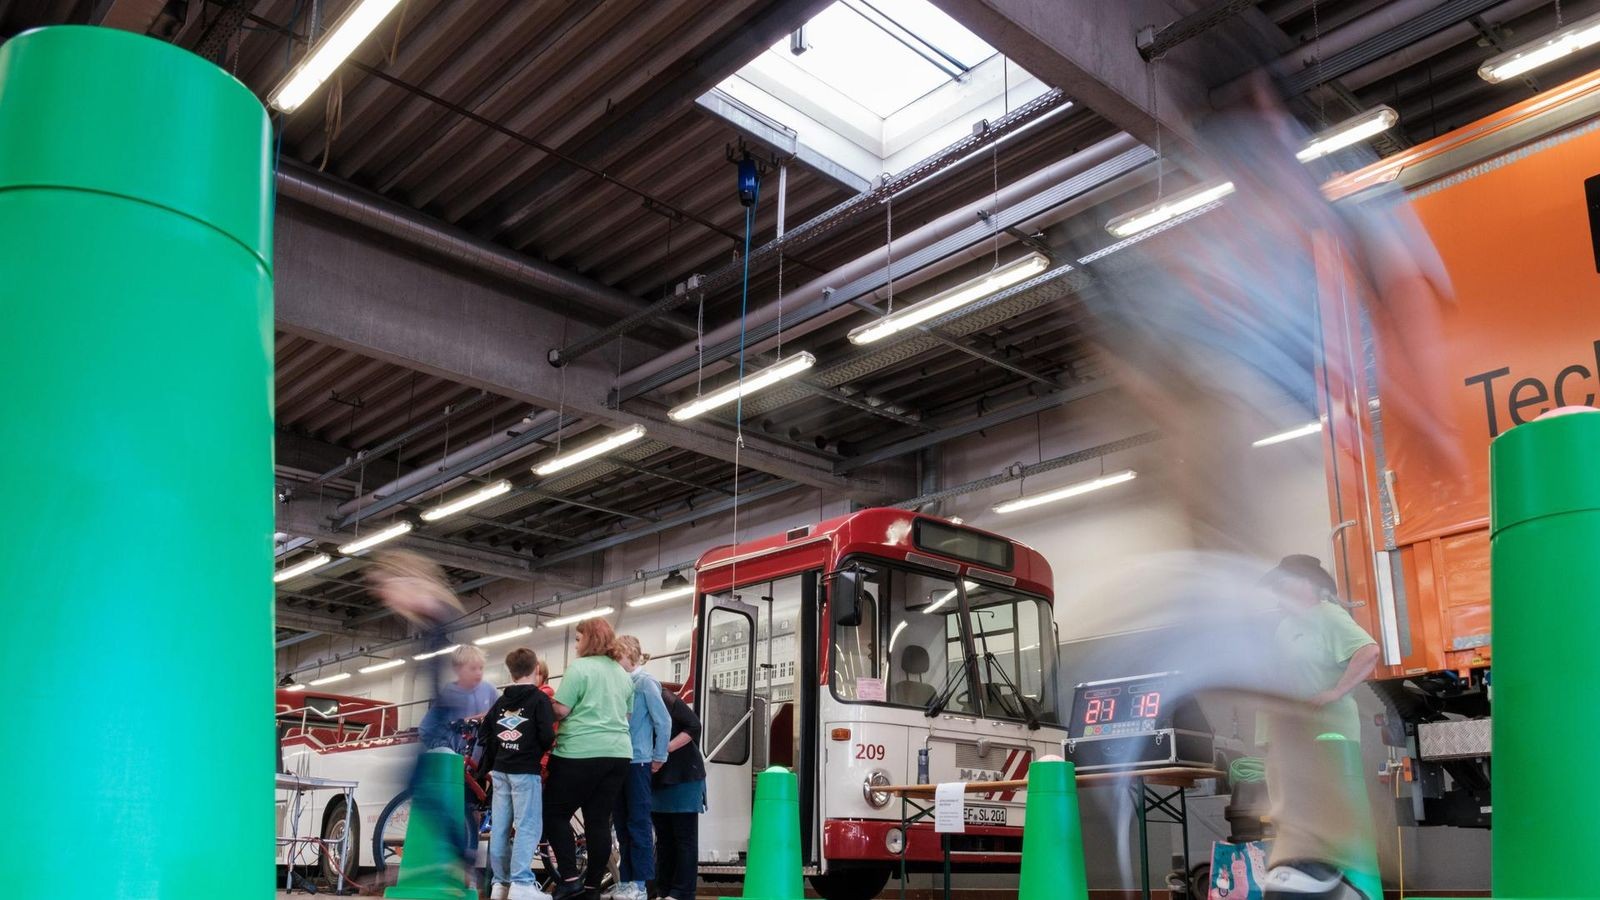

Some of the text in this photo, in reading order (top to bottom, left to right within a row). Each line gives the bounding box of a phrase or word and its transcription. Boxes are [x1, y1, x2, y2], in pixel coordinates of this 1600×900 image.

[1464, 340, 1600, 438] Tec
[1139, 692, 1161, 718] 19
[855, 743, 886, 761] 209
[979, 808, 990, 821] SL
[990, 809, 1005, 822] 201
